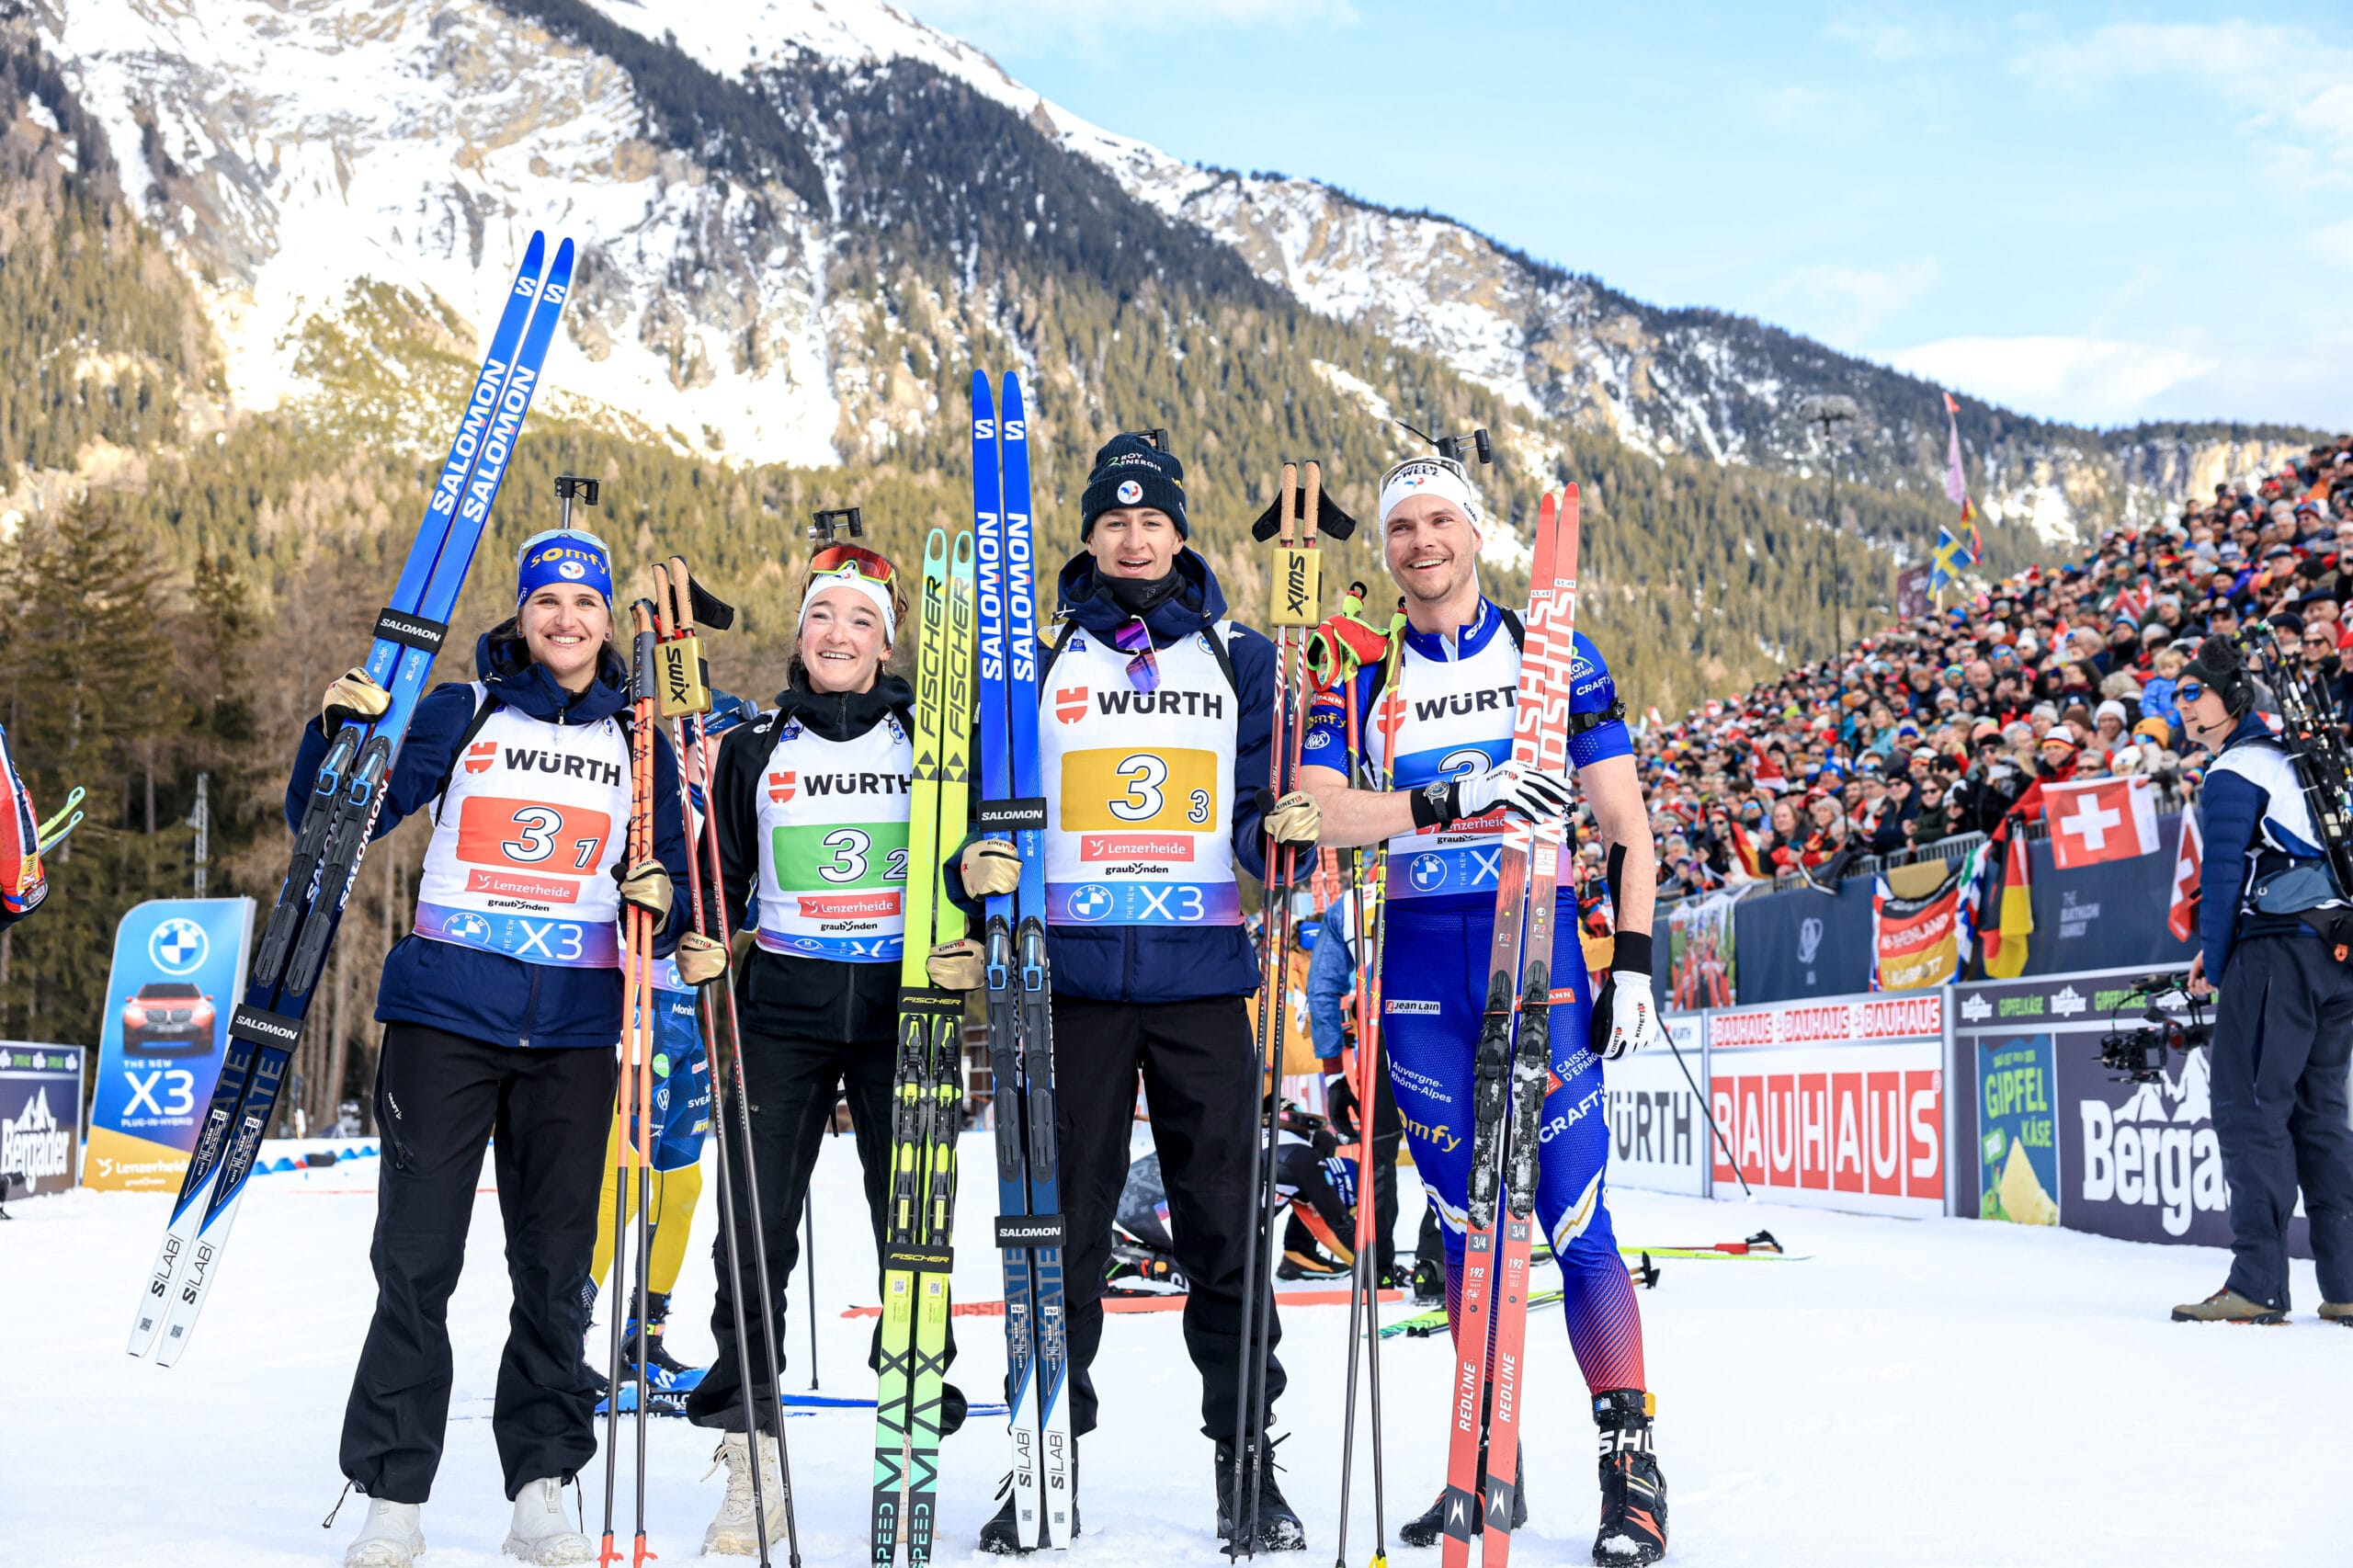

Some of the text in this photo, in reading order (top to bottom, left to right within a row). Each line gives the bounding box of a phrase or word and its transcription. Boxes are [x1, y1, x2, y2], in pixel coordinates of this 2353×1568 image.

[432, 359, 506, 516] SALOMON
[462, 366, 535, 522] SALOMON
[530, 548, 606, 574] somfy
[977, 512, 1003, 681] SALOMON
[1008, 513, 1034, 683] SALOMON
[381, 618, 441, 642] SALOMON
[920, 575, 943, 738] FISCHER
[949, 577, 970, 740] FISCHER
[1415, 686, 1518, 722] WÜRT
[1576, 676, 1607, 697] CRAFT
[1097, 690, 1222, 720] WÜRTH
[505, 747, 620, 787] WÜRTH
[1108, 753, 1210, 824] 3 3
[982, 810, 1043, 821] SALOMON
[339, 778, 390, 910] SALOMON
[502, 806, 598, 869] 3 1
[817, 827, 908, 883] 3 2
[1108, 843, 1186, 855] Lenzerheide
[1353, 846, 1364, 889] EKI
[1471, 847, 1502, 885] X
[494, 879, 571, 898] Lenzerheide
[1138, 885, 1204, 920] X3
[821, 900, 893, 914] Lenzerheide
[514, 919, 584, 960] X3
[903, 996, 961, 1006] FISCHER
[1865, 999, 1941, 1037] BAUHAUS
[235, 1016, 298, 1040] SALOMON
[124, 1059, 173, 1069] THE NEW
[1392, 1061, 1443, 1088] Auvergne-
[1556, 1047, 1589, 1074] CAISSE
[1563, 1052, 1599, 1082] D'EPARG
[122, 1070, 195, 1117] X3
[1391, 1071, 1452, 1103] Rhône-Alpes
[1985, 1067, 2048, 1119] GIPFEL
[1539, 1090, 1600, 1143] CRAFT
[1608, 1091, 1691, 1165] ÜRTH
[1713, 1089, 1938, 1179] BAUHAUS
[2022, 1116, 2052, 1147] KÄSE
[116, 1156, 188, 1176] Lenzerheid
[2080, 1100, 2232, 1236] Berga
[1000, 1227, 1061, 1237] SALOMON
[1473, 1236, 1486, 1249] 3/4
[1512, 1225, 1526, 1238] 3/4
[890, 1253, 949, 1264] FISCHER
[1470, 1267, 1484, 1278] 192
[1508, 1258, 1524, 1268] 192
[1459, 1361, 1476, 1433] REDLINE
[1499, 1353, 1516, 1423] REDLINE
